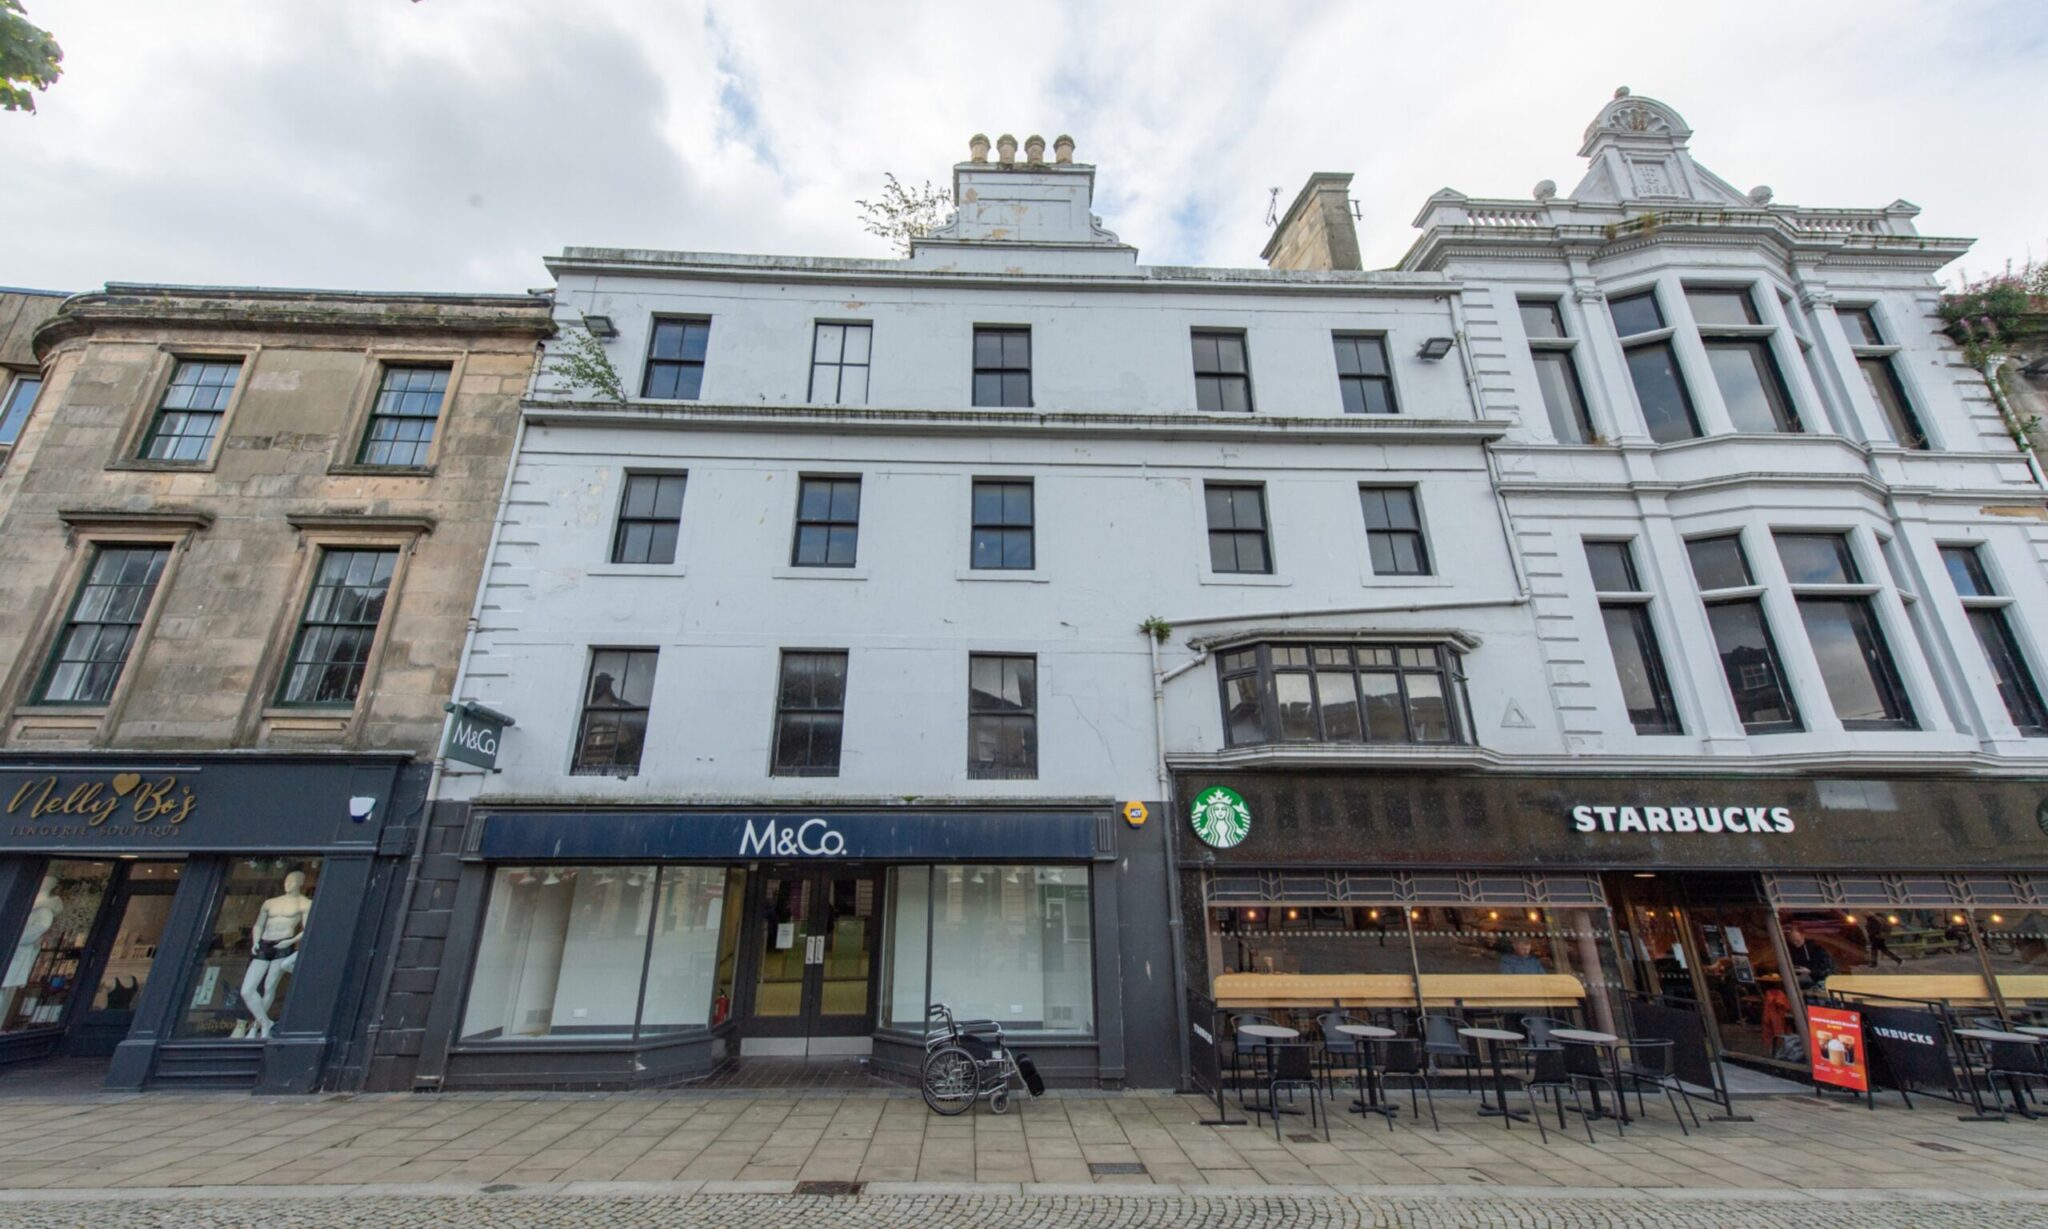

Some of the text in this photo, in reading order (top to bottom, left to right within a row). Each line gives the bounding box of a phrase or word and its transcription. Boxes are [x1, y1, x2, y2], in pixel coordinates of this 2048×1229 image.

[453, 720, 496, 756] M&Co.
[7, 775, 196, 827] Nelly Bo's
[1572, 805, 1796, 833] STARBUCKS
[10, 824, 182, 837] LINGERIE BOUTIQUE
[739, 818, 847, 855] M&Co.
